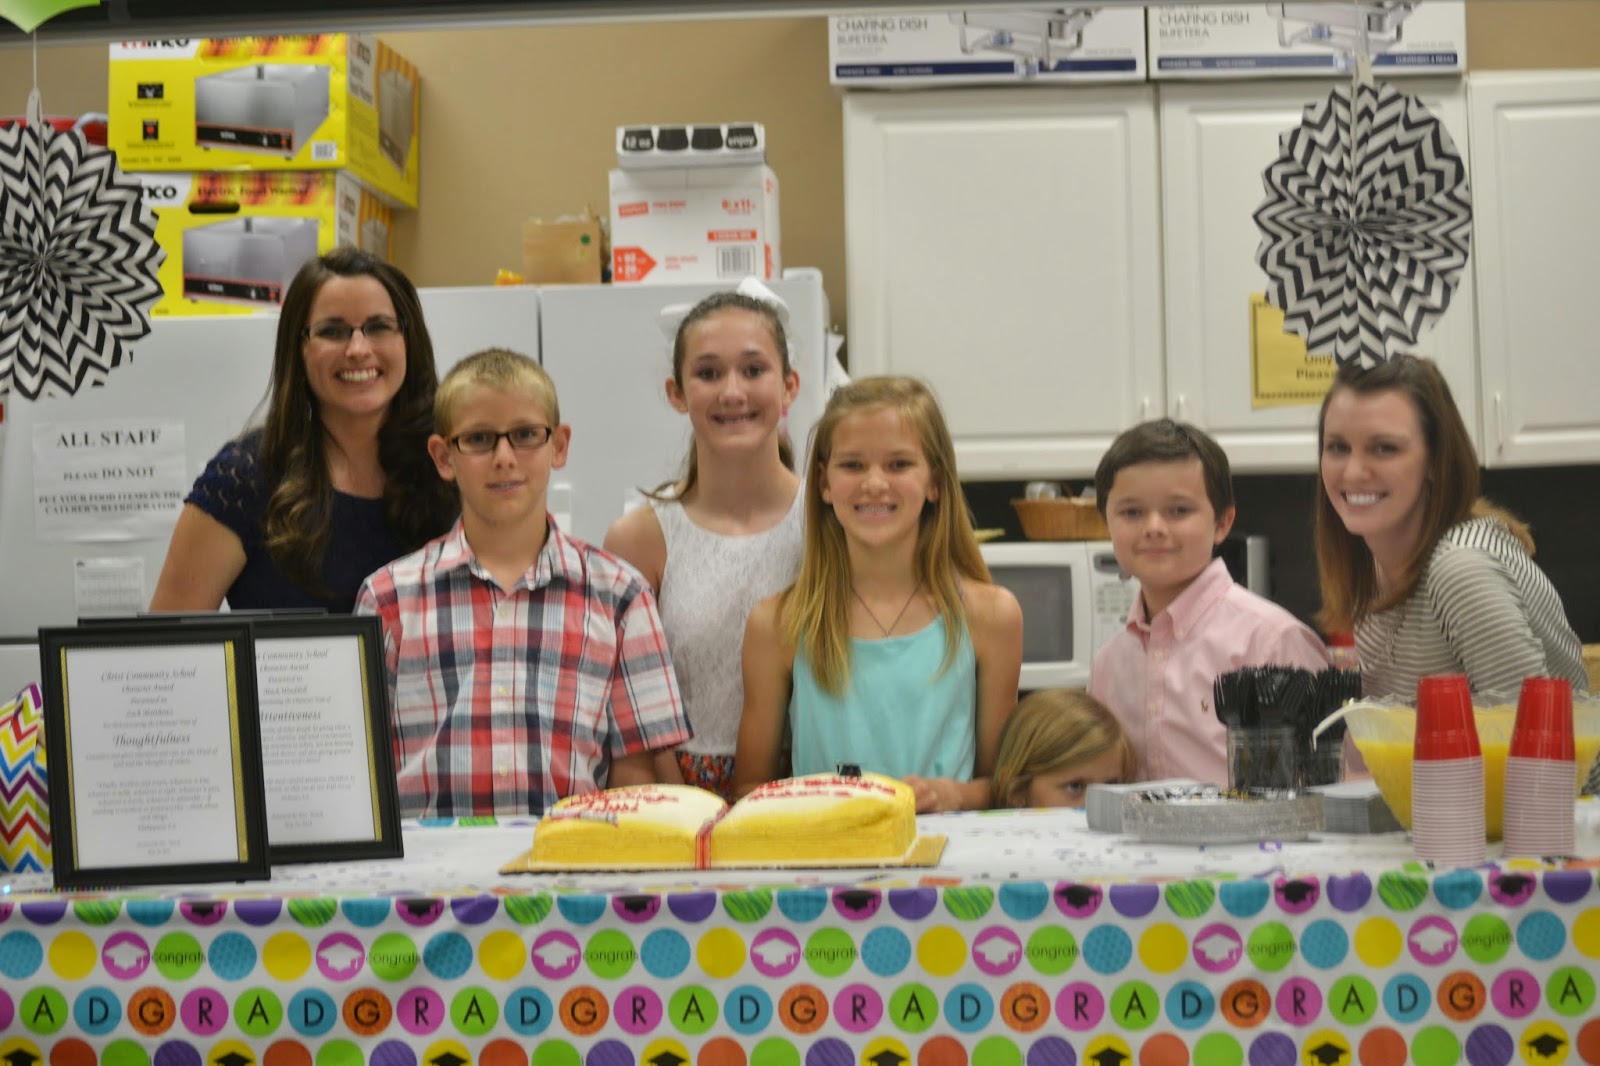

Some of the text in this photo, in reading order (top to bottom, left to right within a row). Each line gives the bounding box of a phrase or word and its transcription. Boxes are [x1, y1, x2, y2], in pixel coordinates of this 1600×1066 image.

[899, 16, 928, 32] DISH
[1221, 11, 1250, 26] DISH
[625, 135, 637, 149] 12
[57, 428, 161, 448] ALL STAFF
[63, 466, 155, 481] PLEASE DO NOT
[60, 493, 87, 503] YOUR
[89, 493, 116, 502] FOOD
[163, 490, 181, 499] THE
[262, 651, 303, 661] Community
[305, 648, 329, 659] School
[126, 670, 170, 682] Community
[172, 667, 197, 679] School
[113, 732, 191, 748] Thoughtfulness
[32, 974, 1582, 1029] A D G R A D G R A D G R A D G R A D G R A D G R A D G R A
